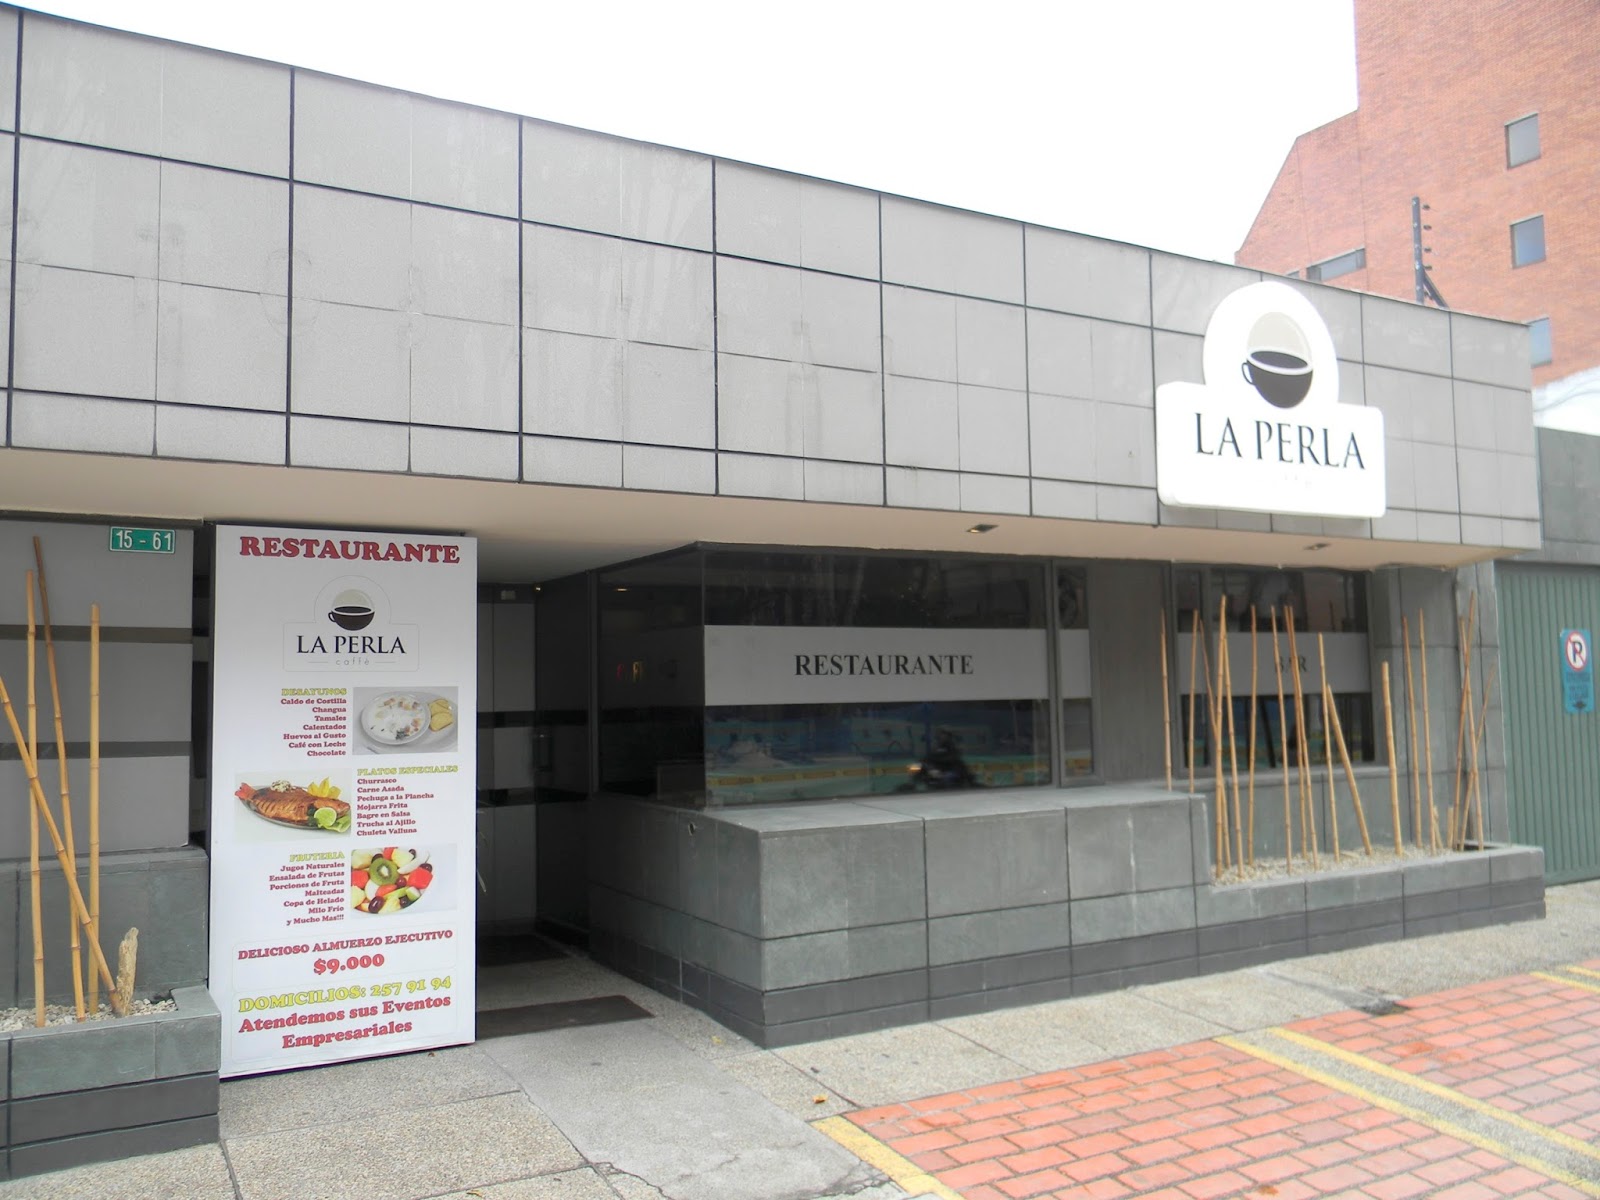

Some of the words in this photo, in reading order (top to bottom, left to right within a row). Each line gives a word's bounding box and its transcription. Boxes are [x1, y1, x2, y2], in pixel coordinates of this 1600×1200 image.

[1195, 412, 1243, 458] LA
[1255, 419, 1366, 470] PERLA
[116, 529, 133, 549] 15
[153, 531, 172, 551] 61
[239, 536, 461, 564] RESTAURANTE
[297, 635, 328, 654] LA
[334, 635, 407, 654] PERLA
[794, 654, 975, 676] RESTAURANTE
[1274, 655, 1307, 672] BR
[281, 687, 347, 696] DESAYUNOS
[312, 706, 347, 714] Changua
[307, 749, 347, 757] Chocolate
[357, 768, 397, 776] PLATOS
[398, 765, 459, 775] ESPECIALES
[382, 785, 405, 793] Asada
[357, 795, 388, 803] Pechuga
[404, 792, 435, 800] Plancha
[357, 803, 388, 811] Mojarra
[357, 820, 385, 828] Trucha
[394, 818, 416, 827] Ajillo
[306, 862, 345, 870] Naturales
[268, 873, 306, 882] Ensalada
[270, 882, 310, 891] Porciones
[304, 888, 344, 897] Malteadas
[316, 897, 344, 905] Helado
[293, 916, 320, 924] Mucho
[238, 944, 310, 960] DELICIOSO
[312, 937, 383, 952] ALMUERZO
[385, 930, 453, 945] EJECUTIVO
[313, 953, 385, 976] $9.000
[238, 985, 367, 1013] DOMICILIOS:
[370, 982, 402, 997] 257
[406, 979, 426, 993] 91
[430, 975, 452, 990] 94
[238, 1010, 346, 1033] Atendemos
[349, 1005, 378, 1019] sus
[382, 996, 451, 1014] Eventos
[282, 1021, 412, 1049] Empresariales
